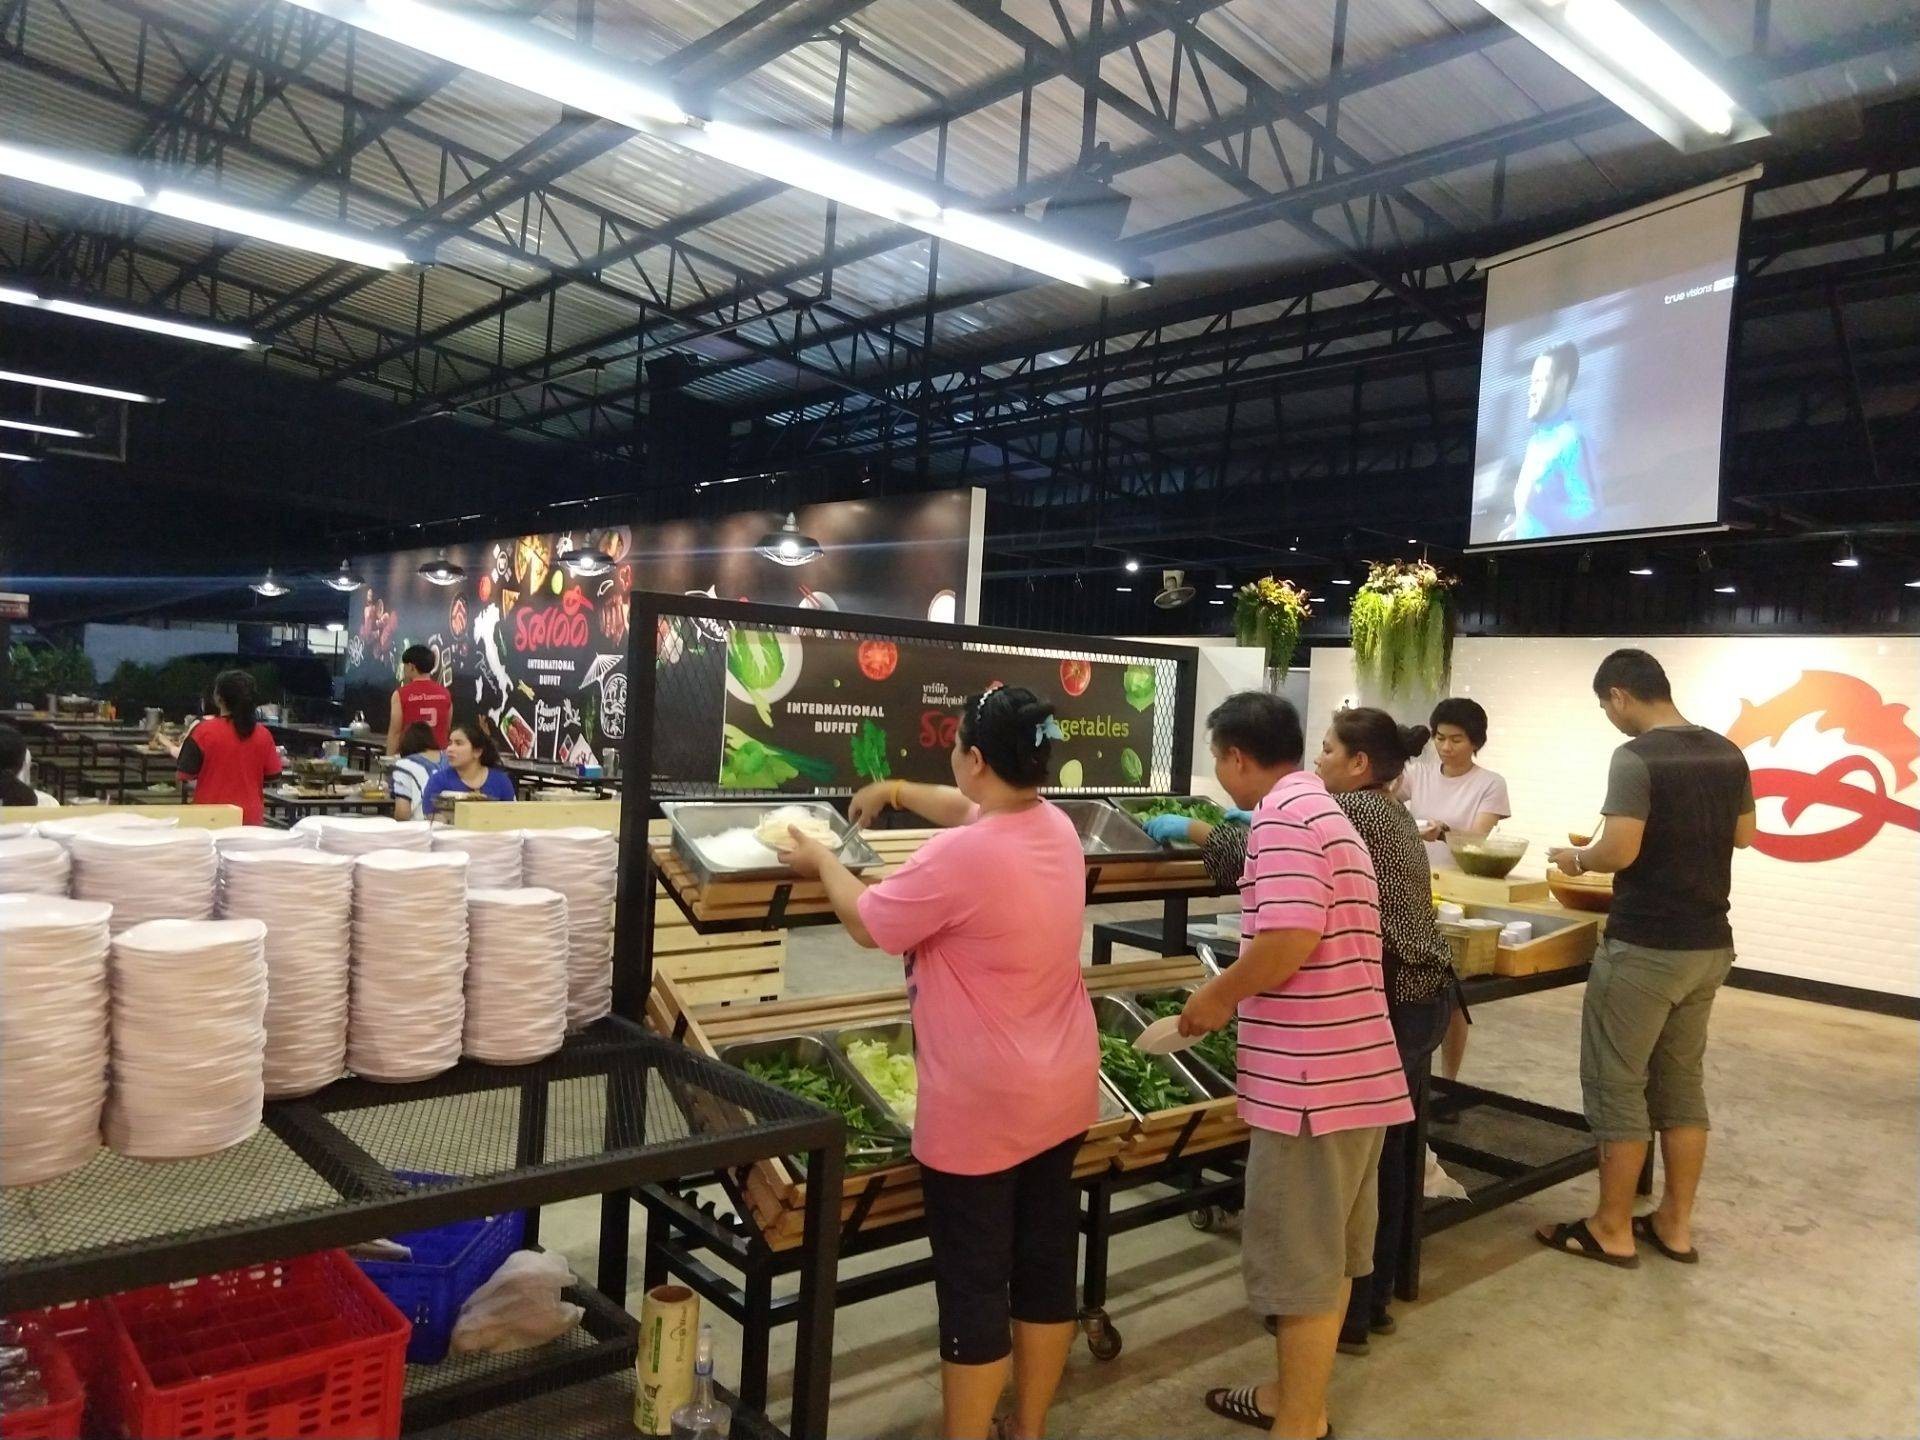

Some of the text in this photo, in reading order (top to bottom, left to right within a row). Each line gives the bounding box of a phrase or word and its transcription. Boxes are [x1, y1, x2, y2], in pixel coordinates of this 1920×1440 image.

[1664, 293, 1685, 304] true
[527, 658, 575, 671] INTERNATIONAL
[539, 674, 561, 686] BUFFET
[787, 702, 885, 717] INTERNATIONAL
[814, 721, 858, 734] BUFFET
[1054, 714, 1130, 742] getables
